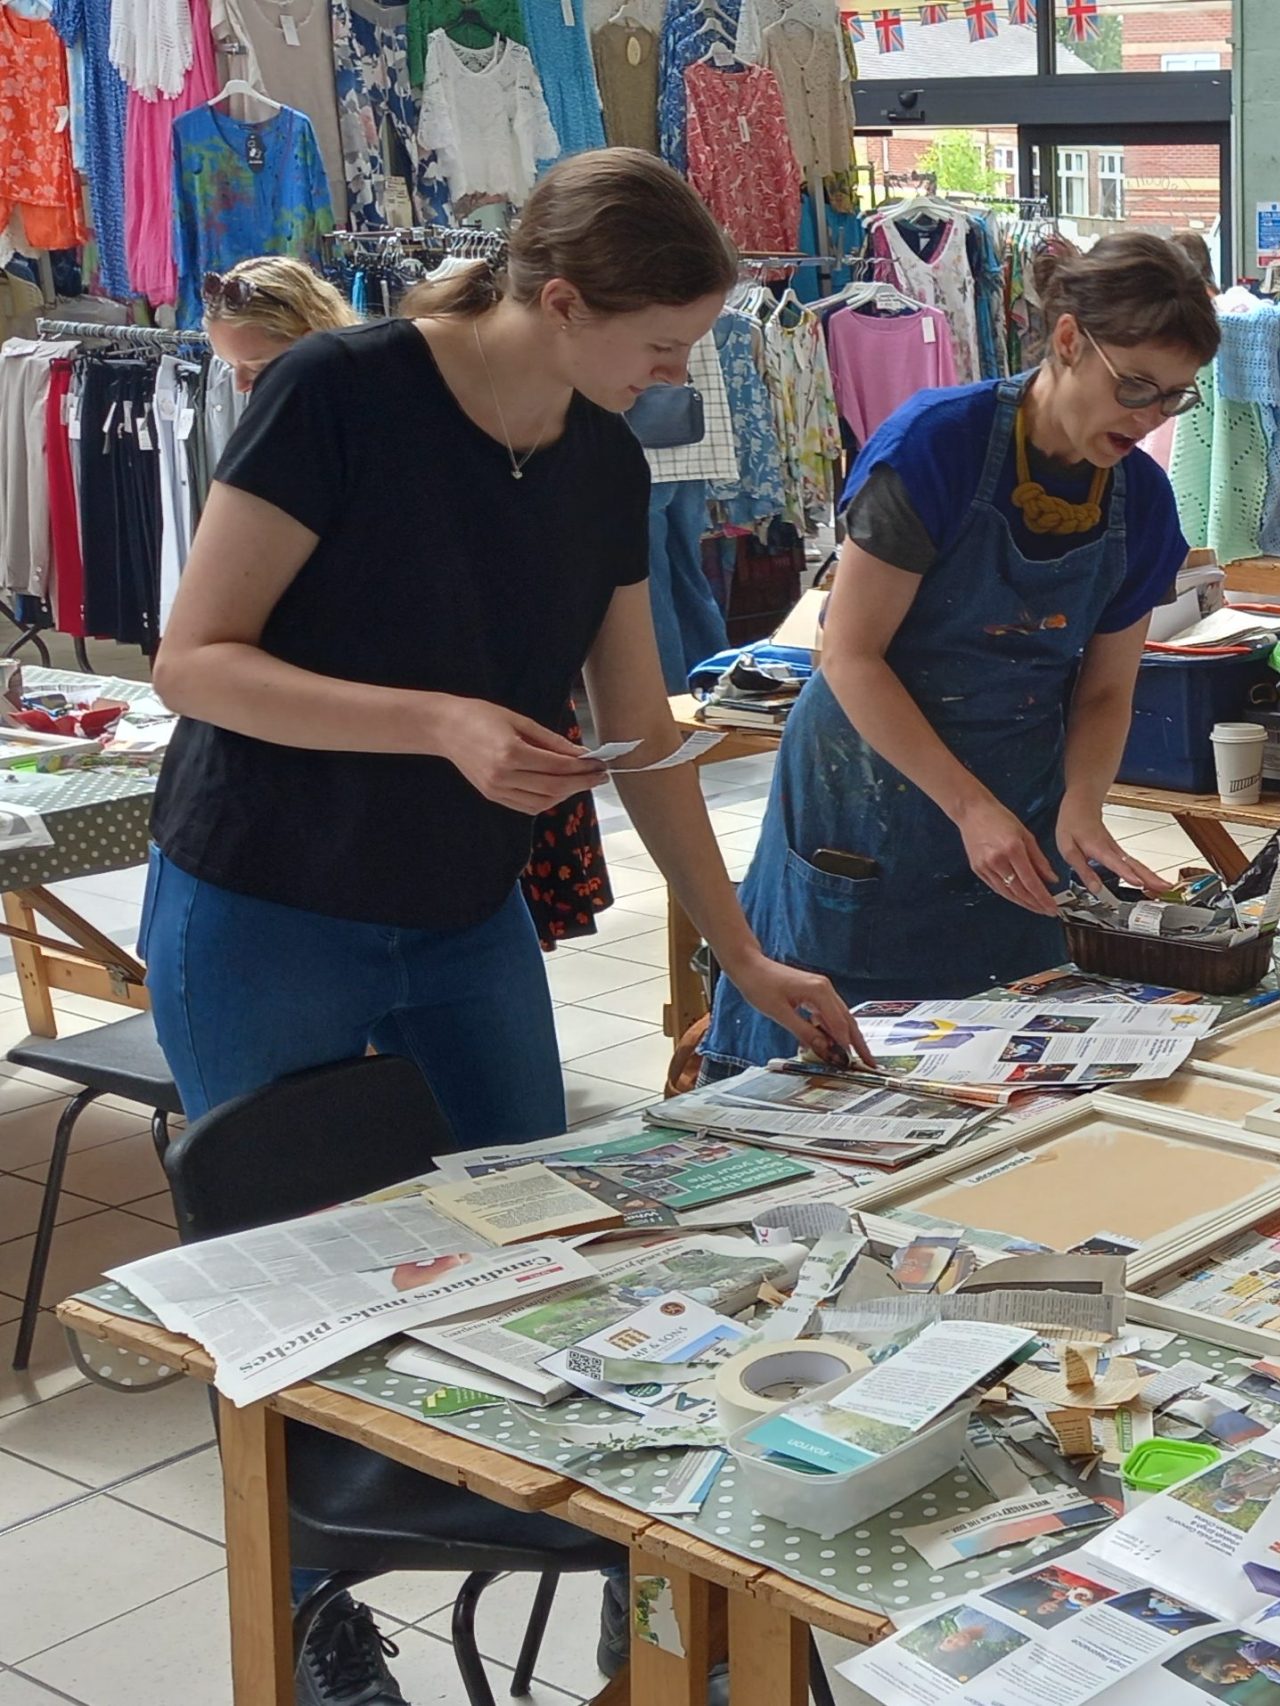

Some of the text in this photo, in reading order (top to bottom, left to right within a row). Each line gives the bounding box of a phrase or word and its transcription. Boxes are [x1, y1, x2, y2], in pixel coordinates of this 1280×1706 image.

[687, 1156, 772, 1182] of your life
[692, 1160, 784, 1190] soundtrack
[710, 1165, 795, 1192] Create the
[239, 1255, 553, 1374] Candidates make pitches
[660, 1325, 689, 1346] SONS
